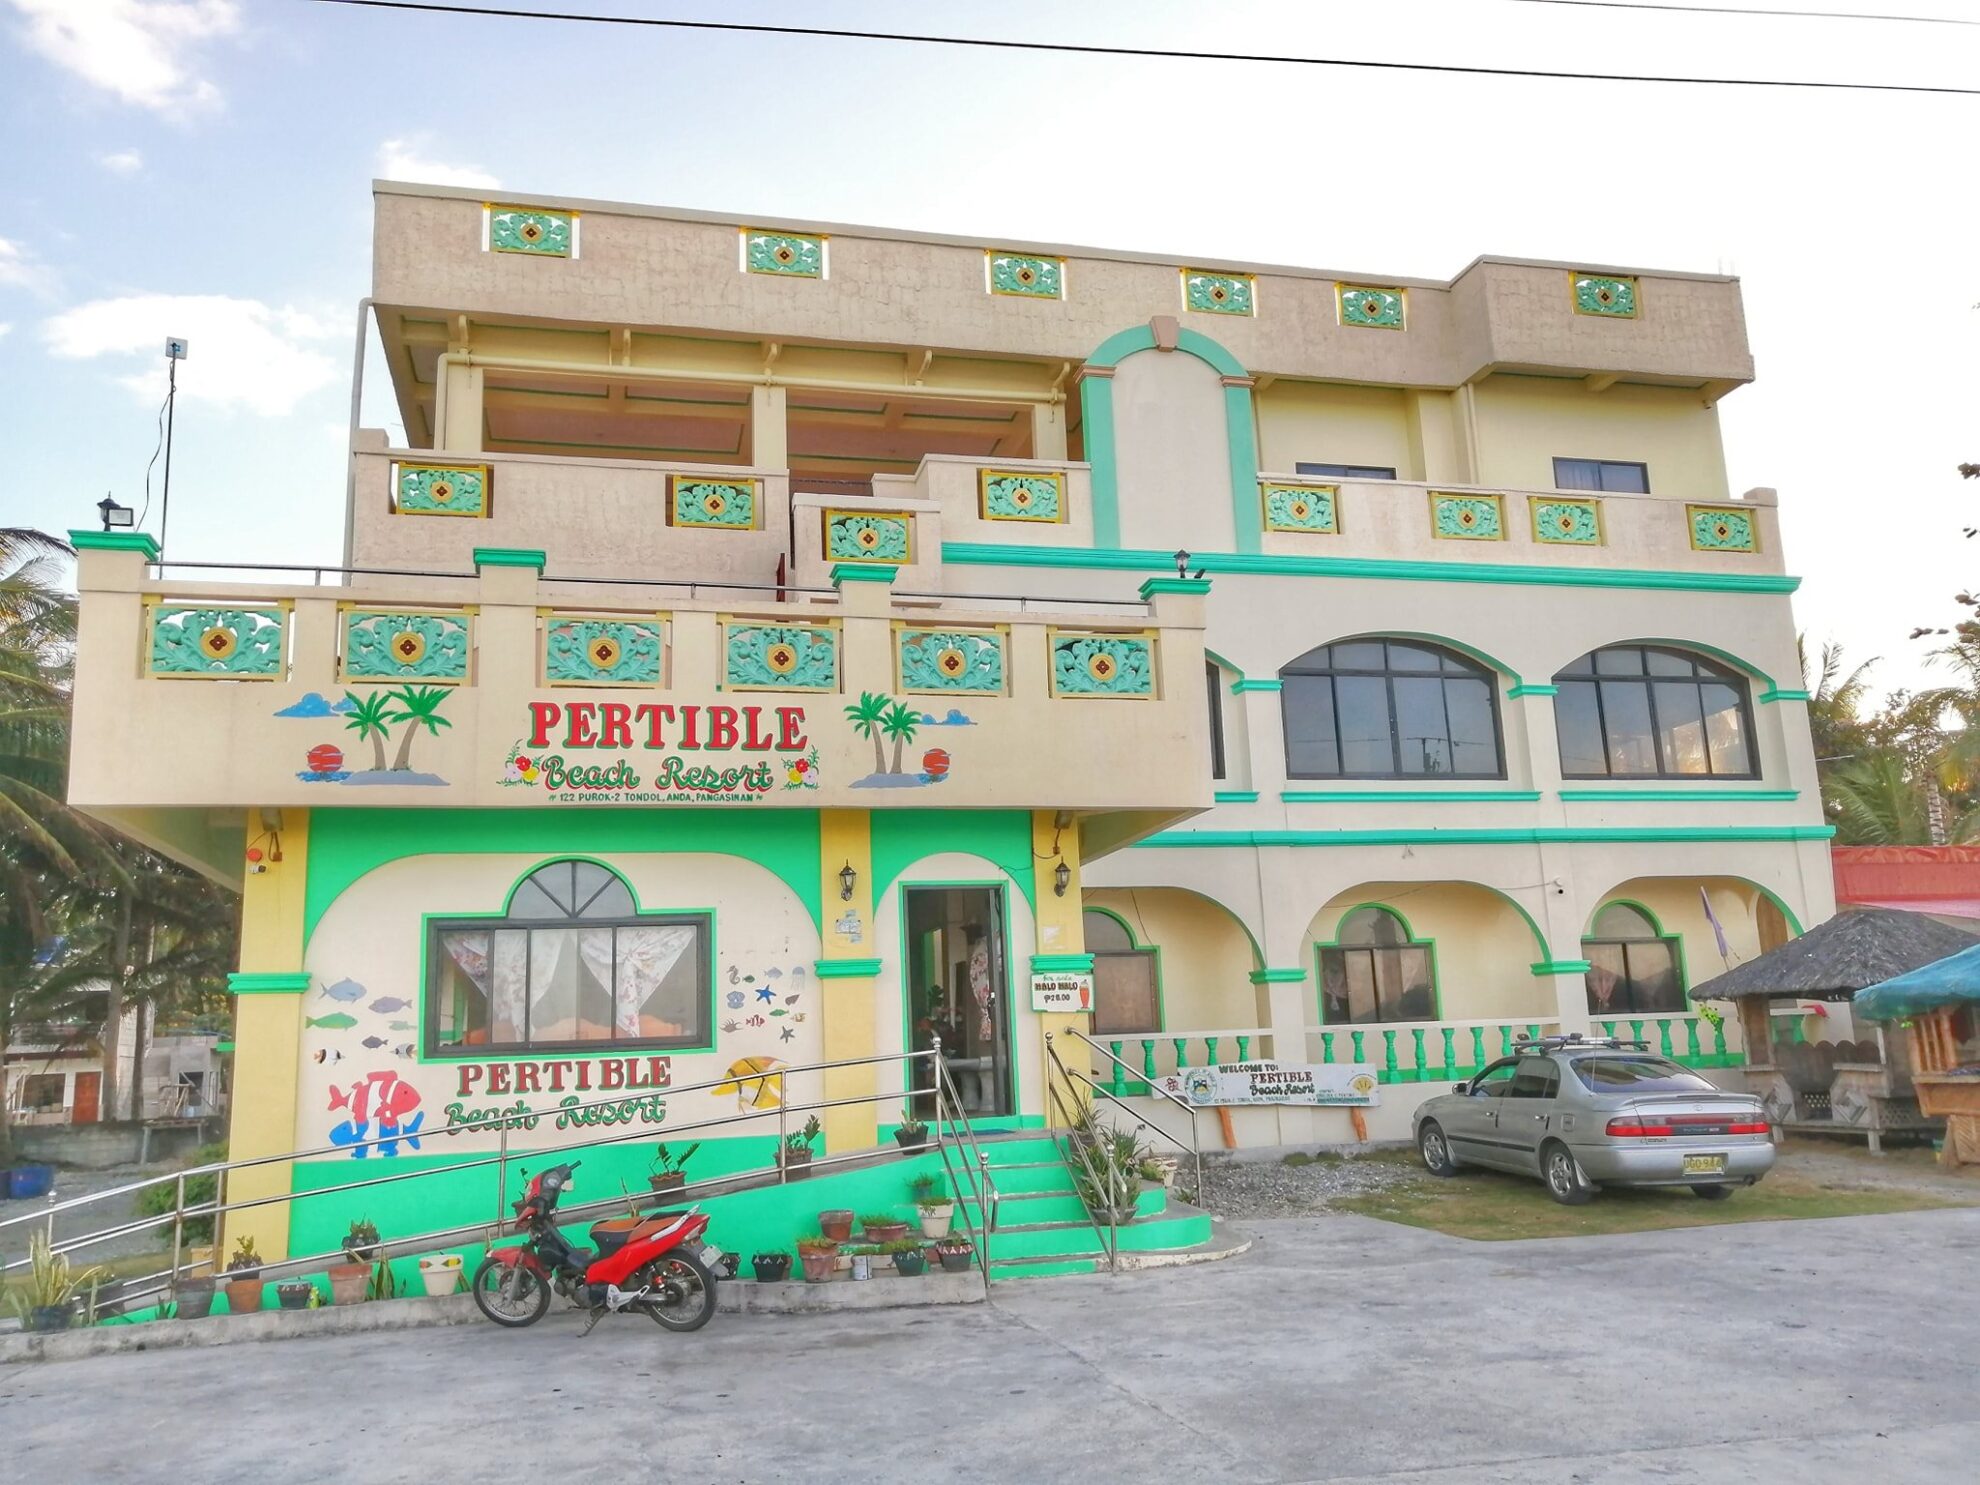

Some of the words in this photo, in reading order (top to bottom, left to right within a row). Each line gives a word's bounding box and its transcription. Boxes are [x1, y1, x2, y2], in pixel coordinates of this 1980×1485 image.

[527, 701, 809, 752] PERTIBLE
[541, 755, 641, 791] Beach
[655, 755, 774, 792] Resort
[560, 793, 575, 801] 122
[579, 793, 620, 801] PUROK-2
[624, 793, 665, 802] TONDOL,
[666, 793, 695, 802] ANDA,
[696, 793, 754, 801] PANGASINAN
[1034, 982, 1056, 991] HALO
[1058, 982, 1078, 991] HALO
[1218, 1064, 1263, 1074] WELCOME
[1265, 1063, 1279, 1072] TO:
[457, 1056, 671, 1097] PERTIBLE
[1250, 1071, 1313, 1084] PERTIBLE
[1249, 1084, 1283, 1096] Beach
[1284, 1083, 1315, 1095] Resort
[444, 1100, 540, 1136] Beach
[556, 1095, 667, 1130] Resort
